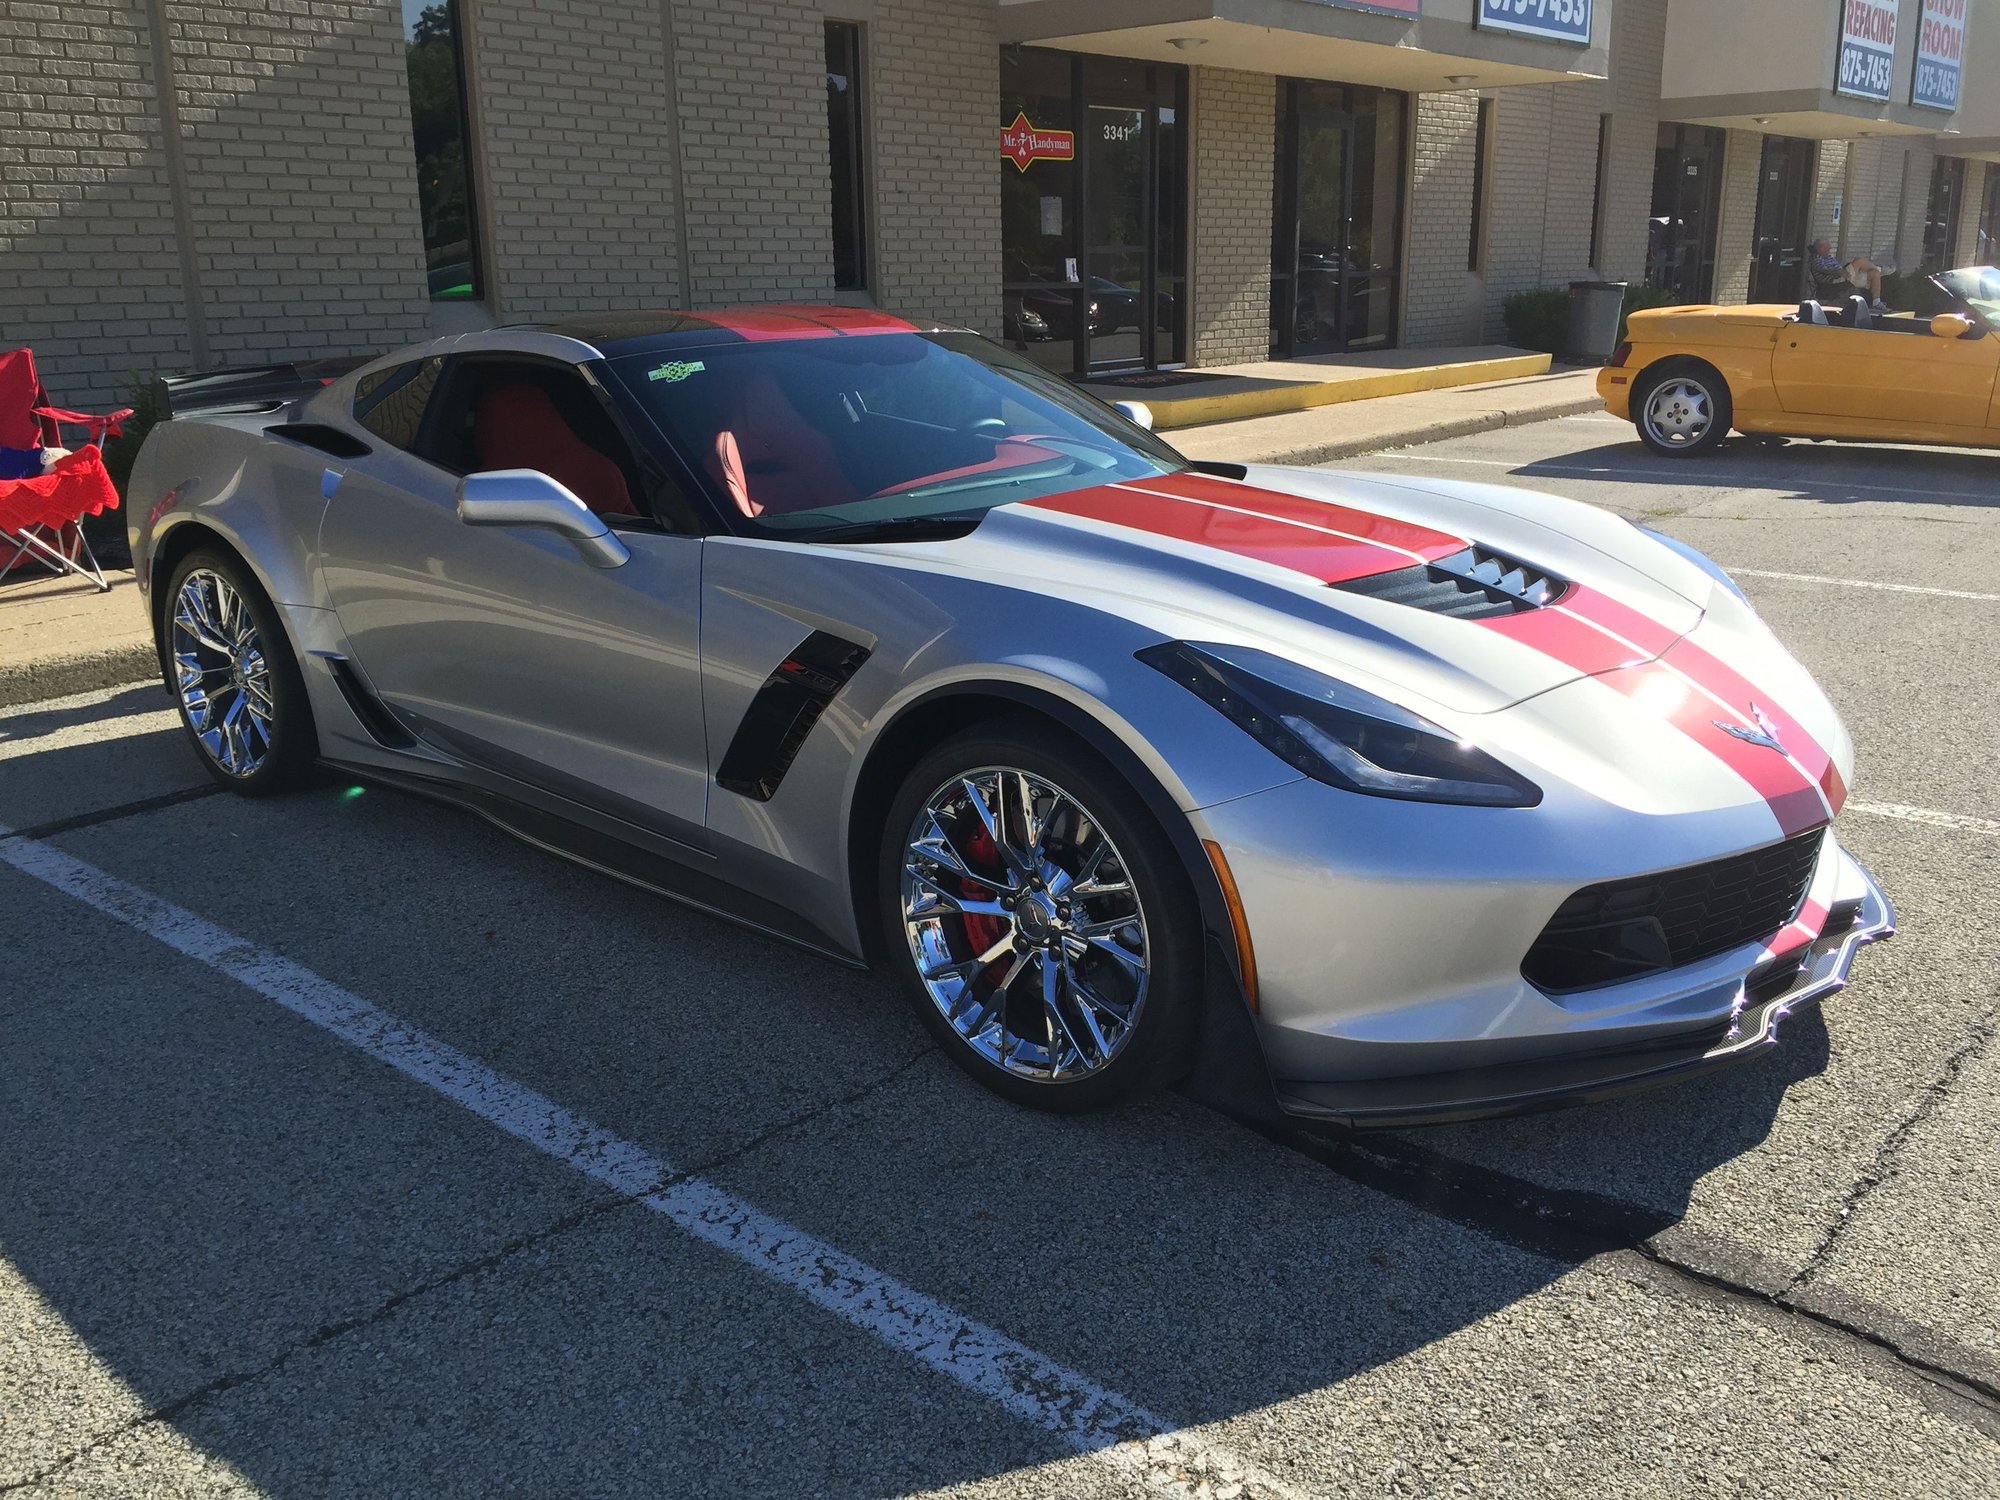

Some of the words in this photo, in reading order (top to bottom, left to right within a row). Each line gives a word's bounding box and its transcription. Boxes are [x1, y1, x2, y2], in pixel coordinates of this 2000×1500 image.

[1488, 0, 1585, 26] -7453
[1845, 0, 1895, 46] REFACING
[1921, 18, 1961, 60] ROOM
[1841, 48, 1891, 91] 875-7453
[1917, 64, 1957, 101] 875-7453
[1003, 134, 1017, 147] Mr.
[1028, 134, 1070, 151] Handyman
[1103, 124, 1128, 141] 3341
